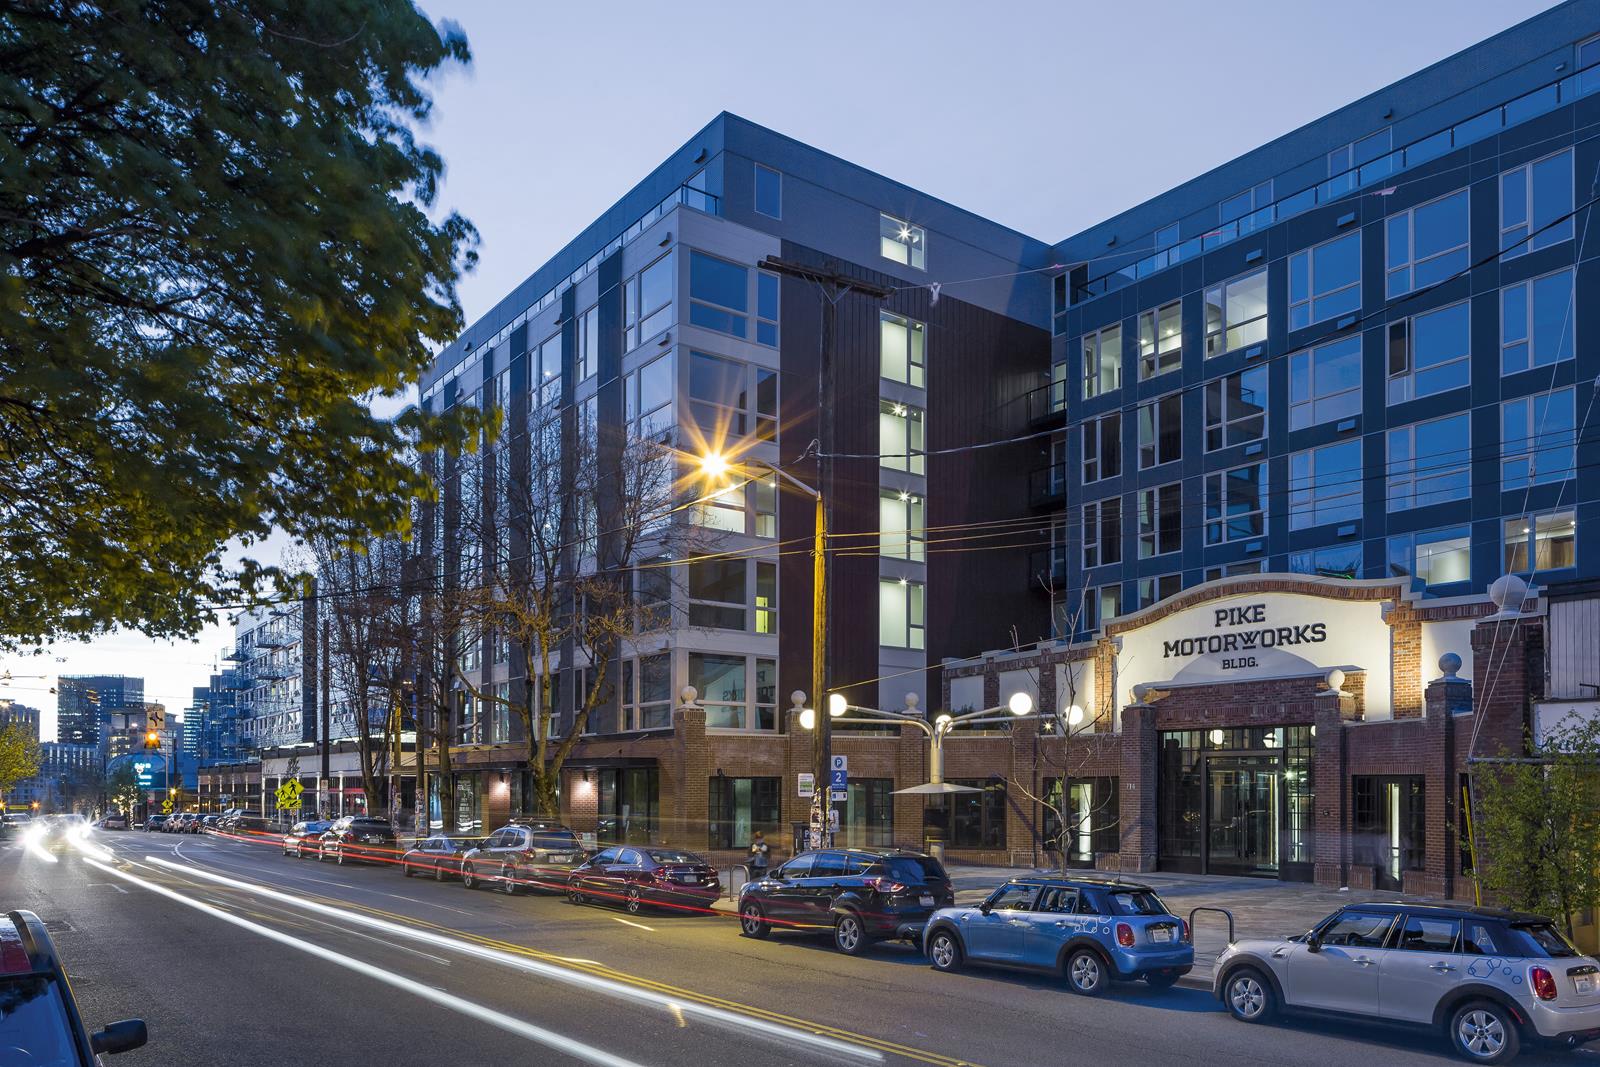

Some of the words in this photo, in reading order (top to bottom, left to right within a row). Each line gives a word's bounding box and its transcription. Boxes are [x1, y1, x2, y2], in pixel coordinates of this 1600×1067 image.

[1214, 603, 1266, 627] PIKE
[1163, 622, 1327, 658] MOTORWORKS
[1222, 656, 1259, 670] BLDG.
[836, 759, 842, 767] P
[835, 771, 842, 783] 2
